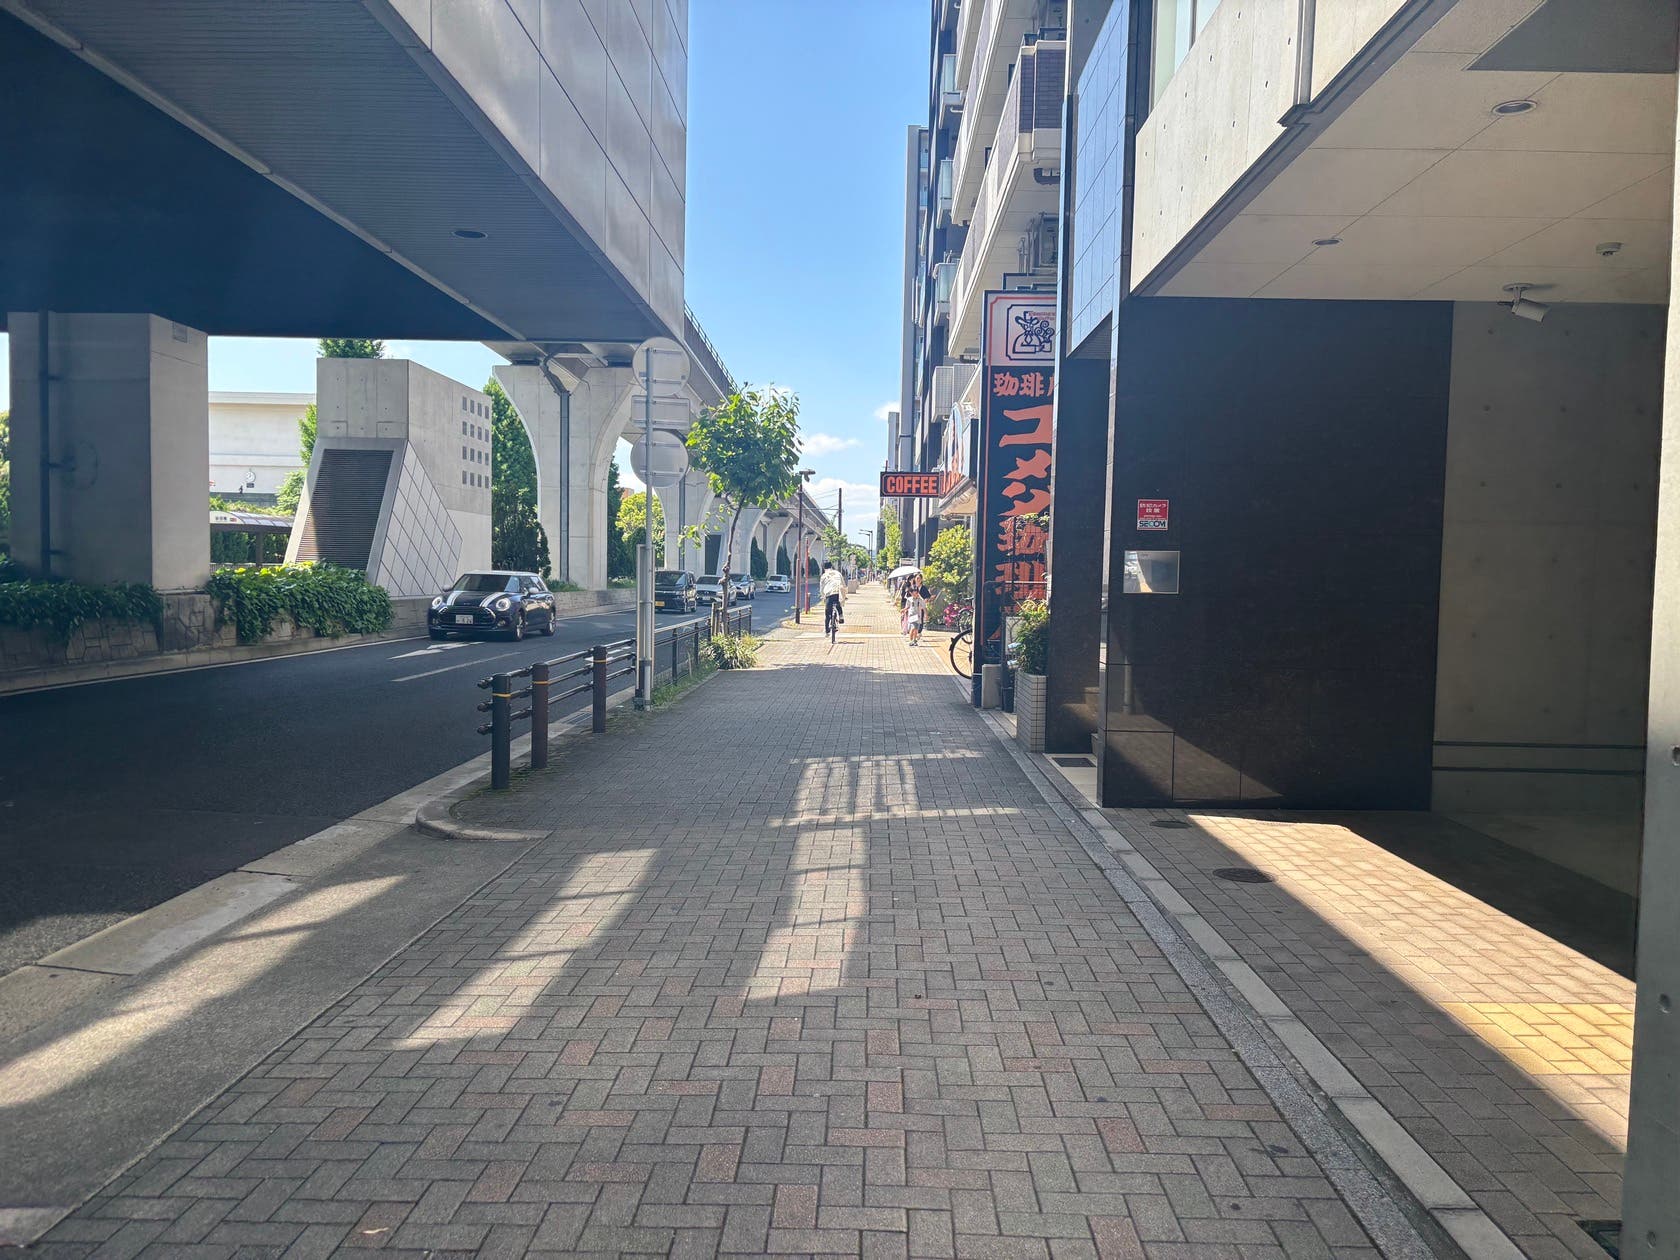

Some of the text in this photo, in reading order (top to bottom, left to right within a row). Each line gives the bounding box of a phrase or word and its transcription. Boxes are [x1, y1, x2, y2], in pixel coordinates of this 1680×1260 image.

[887, 476, 937, 495] COFFEE
[988, 404, 1053, 641] コメダ珈琲
[1139, 520, 1166, 528] SECOM
